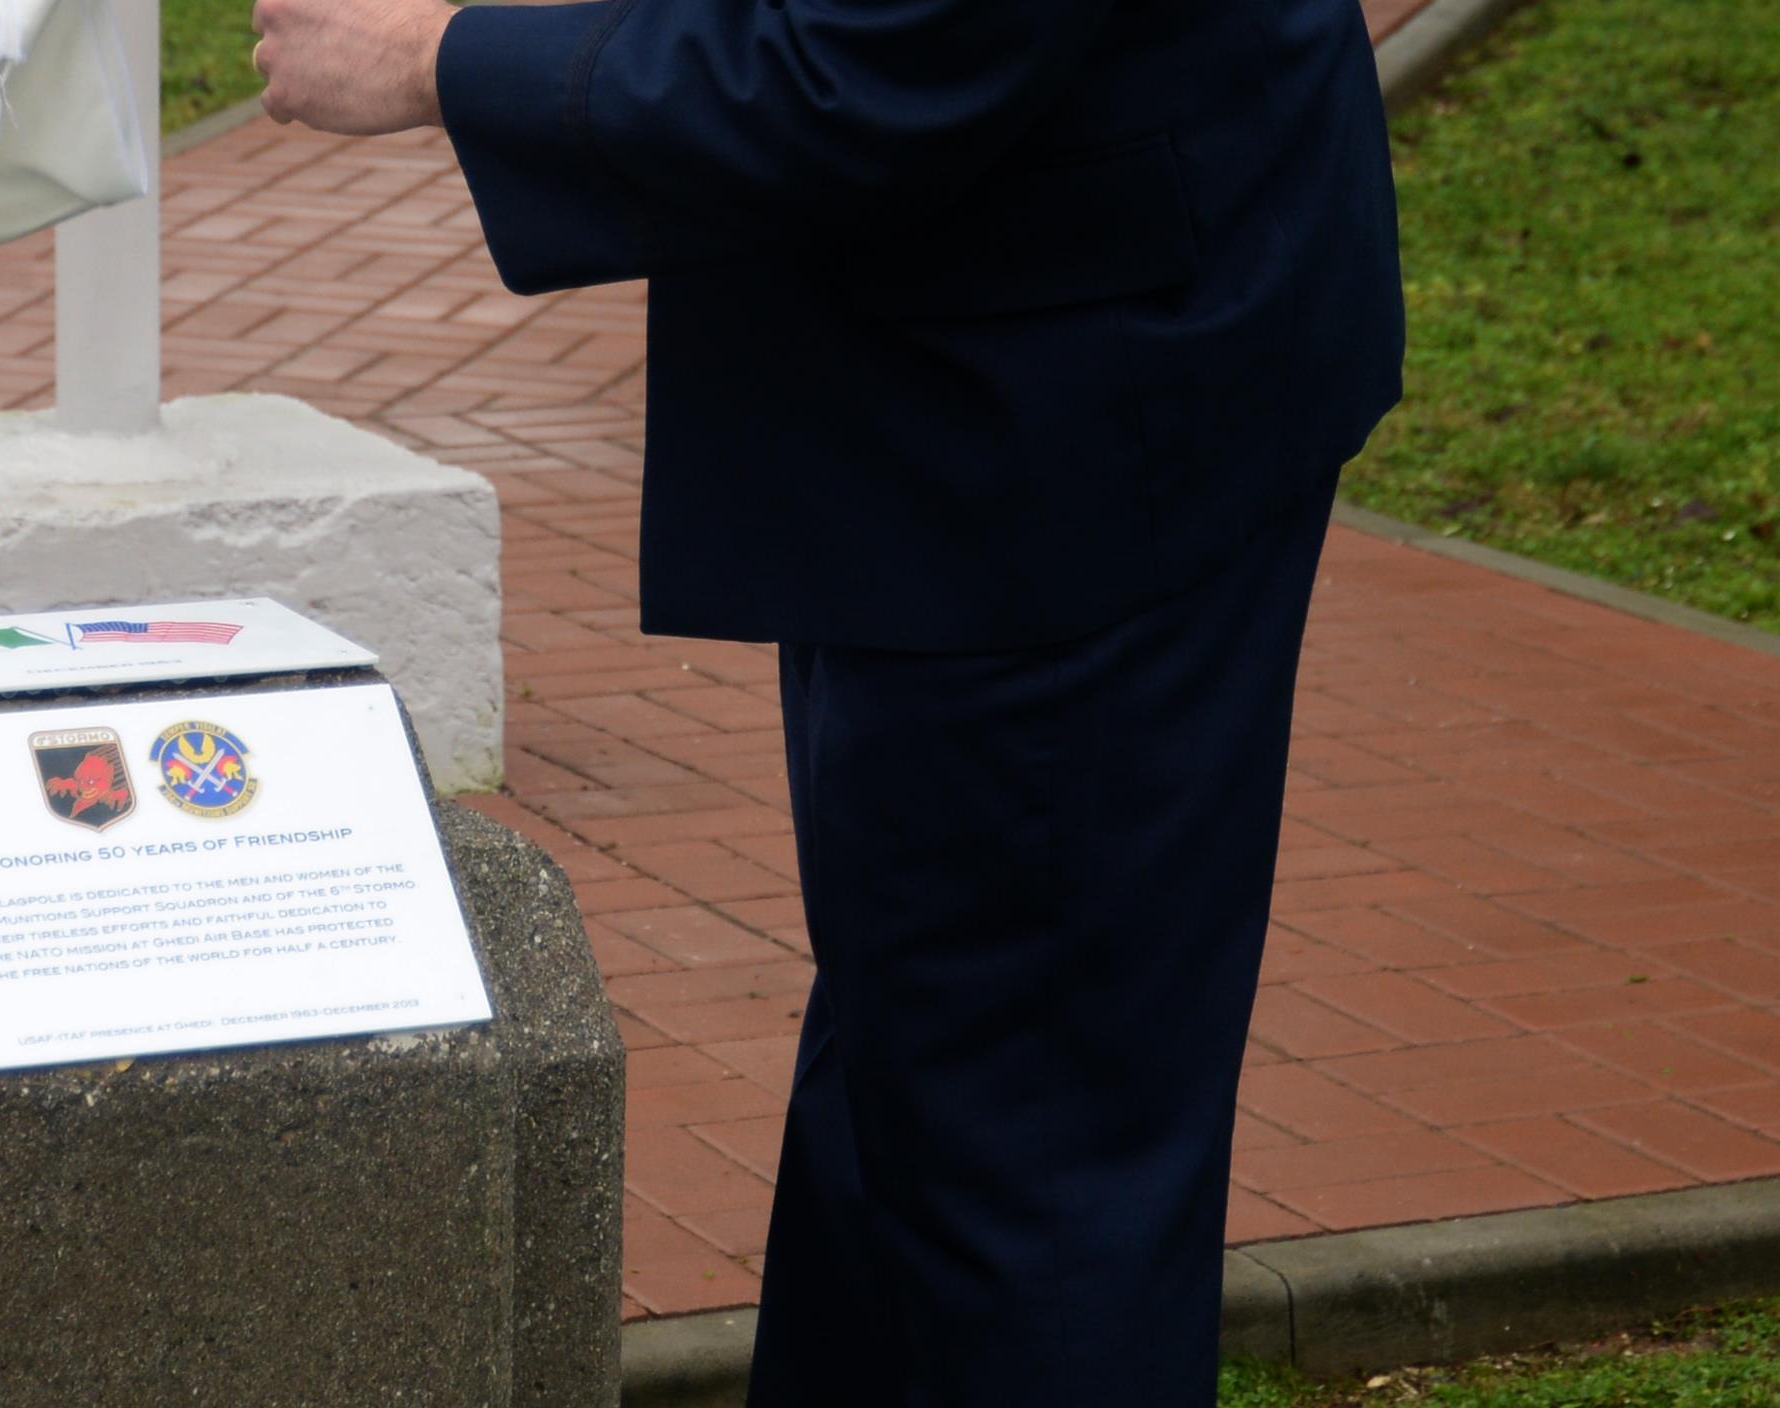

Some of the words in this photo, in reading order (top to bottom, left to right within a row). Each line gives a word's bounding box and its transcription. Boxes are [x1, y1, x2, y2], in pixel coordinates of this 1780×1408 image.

[98, 845, 126, 861] 50
[131, 840, 197, 857] YEARS
[203, 837, 228, 852] OF
[234, 828, 353, 849] FRIENDSHIP
[70, 892, 84, 902] IS
[86, 883, 170, 900] DEDICATED
[174, 881, 192, 892] TO
[196, 879, 224, 890] THE
[227, 876, 259, 888] MEN
[263, 873, 293, 885] AND
[296, 868, 351, 882] WOMEN
[354, 866, 372, 876] OF
[375, 863, 405, 873] THE
[29, 926, 99, 942] TIRELESS
[102, 920, 169, 935] EFFORTS
[172, 916, 203, 928] AND
[206, 910, 275, 926] FAITHFUL
[277, 903, 365, 919] DEDICATION
[367, 900, 387, 910] TO
[80, 902, 150, 918] SUPPORT
[154, 895, 238, 912] SQUADRON
[242, 893, 272, 905] AND
[276, 891, 295, 902] OF
[297, 888, 327, 899] THE
[17, 946, 63, 961] NATO
[67, 941, 127, 956] MISSION
[131, 939, 149, 950] AT
[152, 935, 199, 948] GHEDI
[203, 932, 228, 944] AIR
[231, 928, 272, 942] BASE
[275, 925, 305, 937] HAS
[308, 918, 394, 934] PROTECTED
[23, 966, 62, 979] FREE
[65, 960, 130, 975] NATIONS
[132, 958, 151, 968] OF
[155, 954, 185, 966] THE
[188, 949, 240, 963] WORLD
[243, 946, 273, 958] FOR
[276, 942, 312, 955] HALF
[317, 940, 327, 951] A
